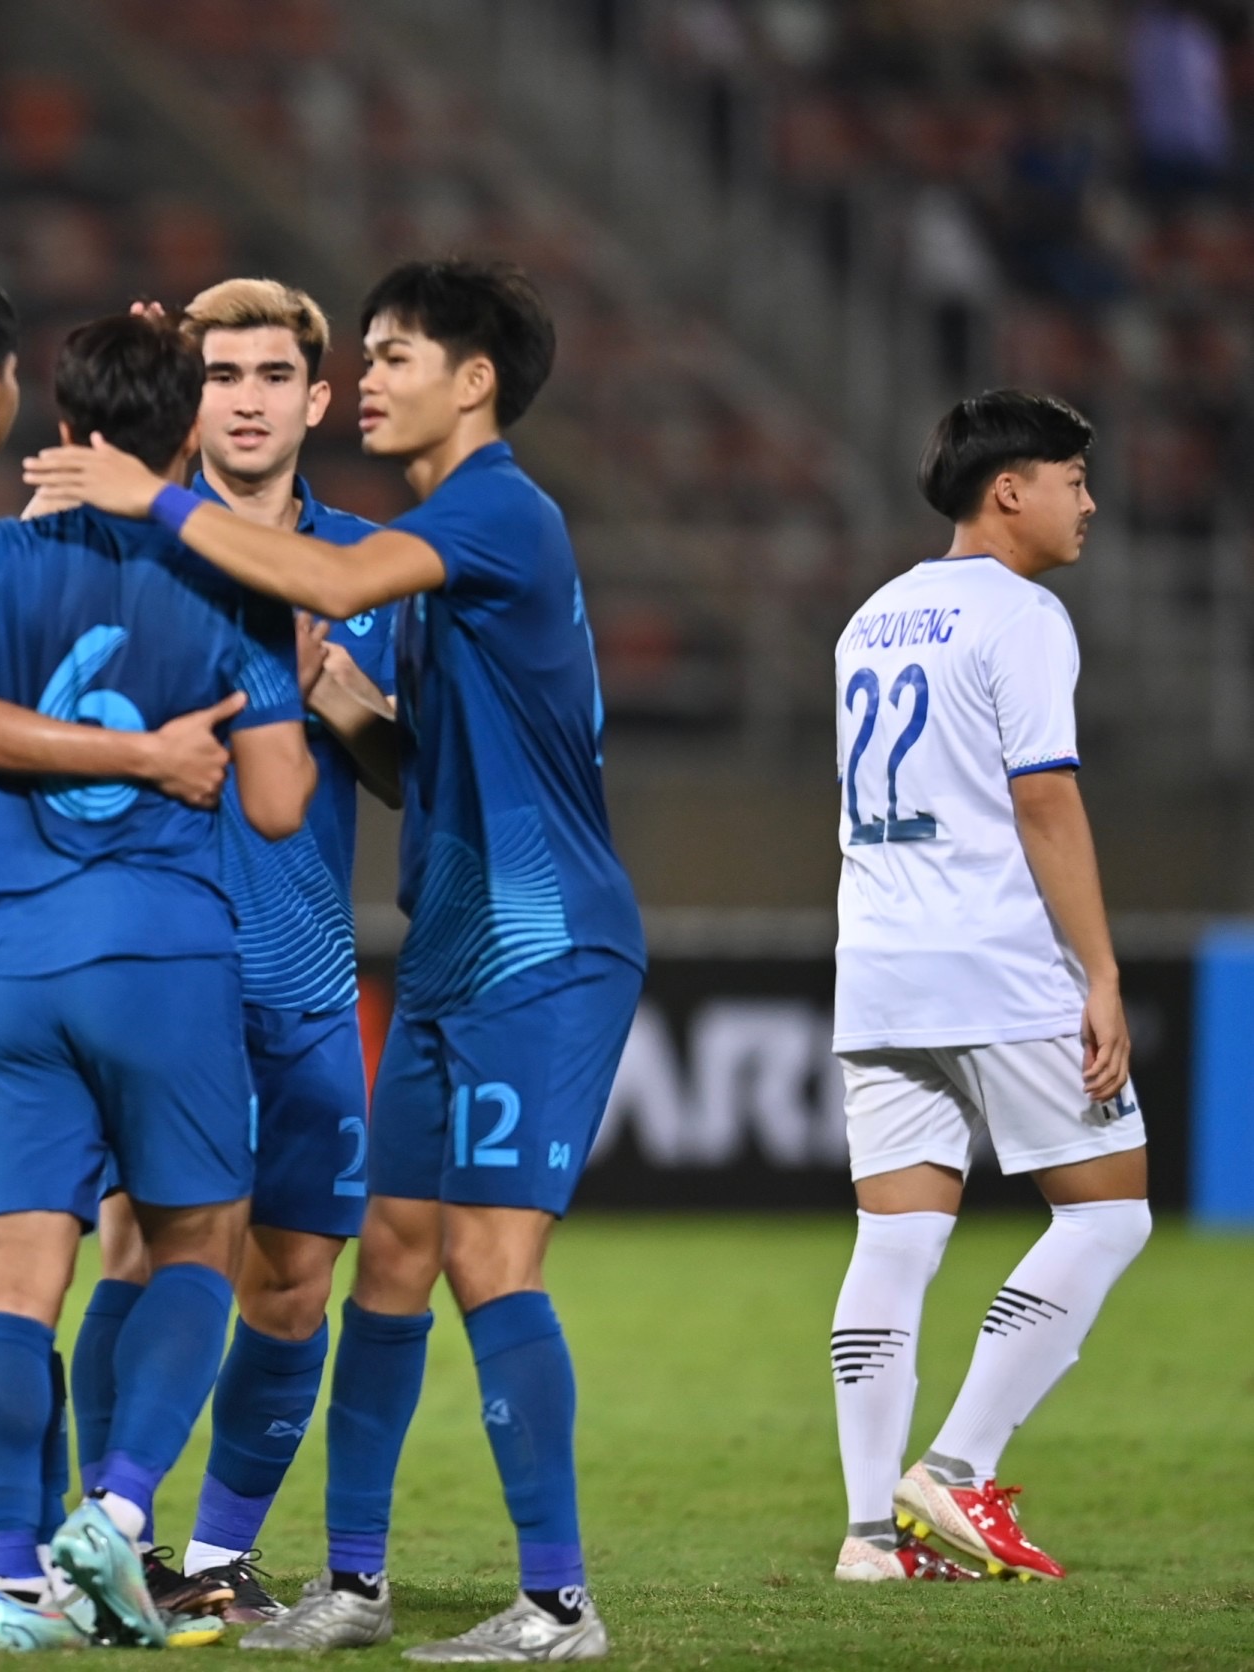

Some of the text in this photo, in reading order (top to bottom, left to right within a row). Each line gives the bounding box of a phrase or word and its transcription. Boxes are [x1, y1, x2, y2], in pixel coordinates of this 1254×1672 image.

[845, 608, 960, 652] PHOUVIENG
[36, 623, 146, 821] 6
[845, 663, 937, 845] 22
[454, 1082, 521, 1168] 12
